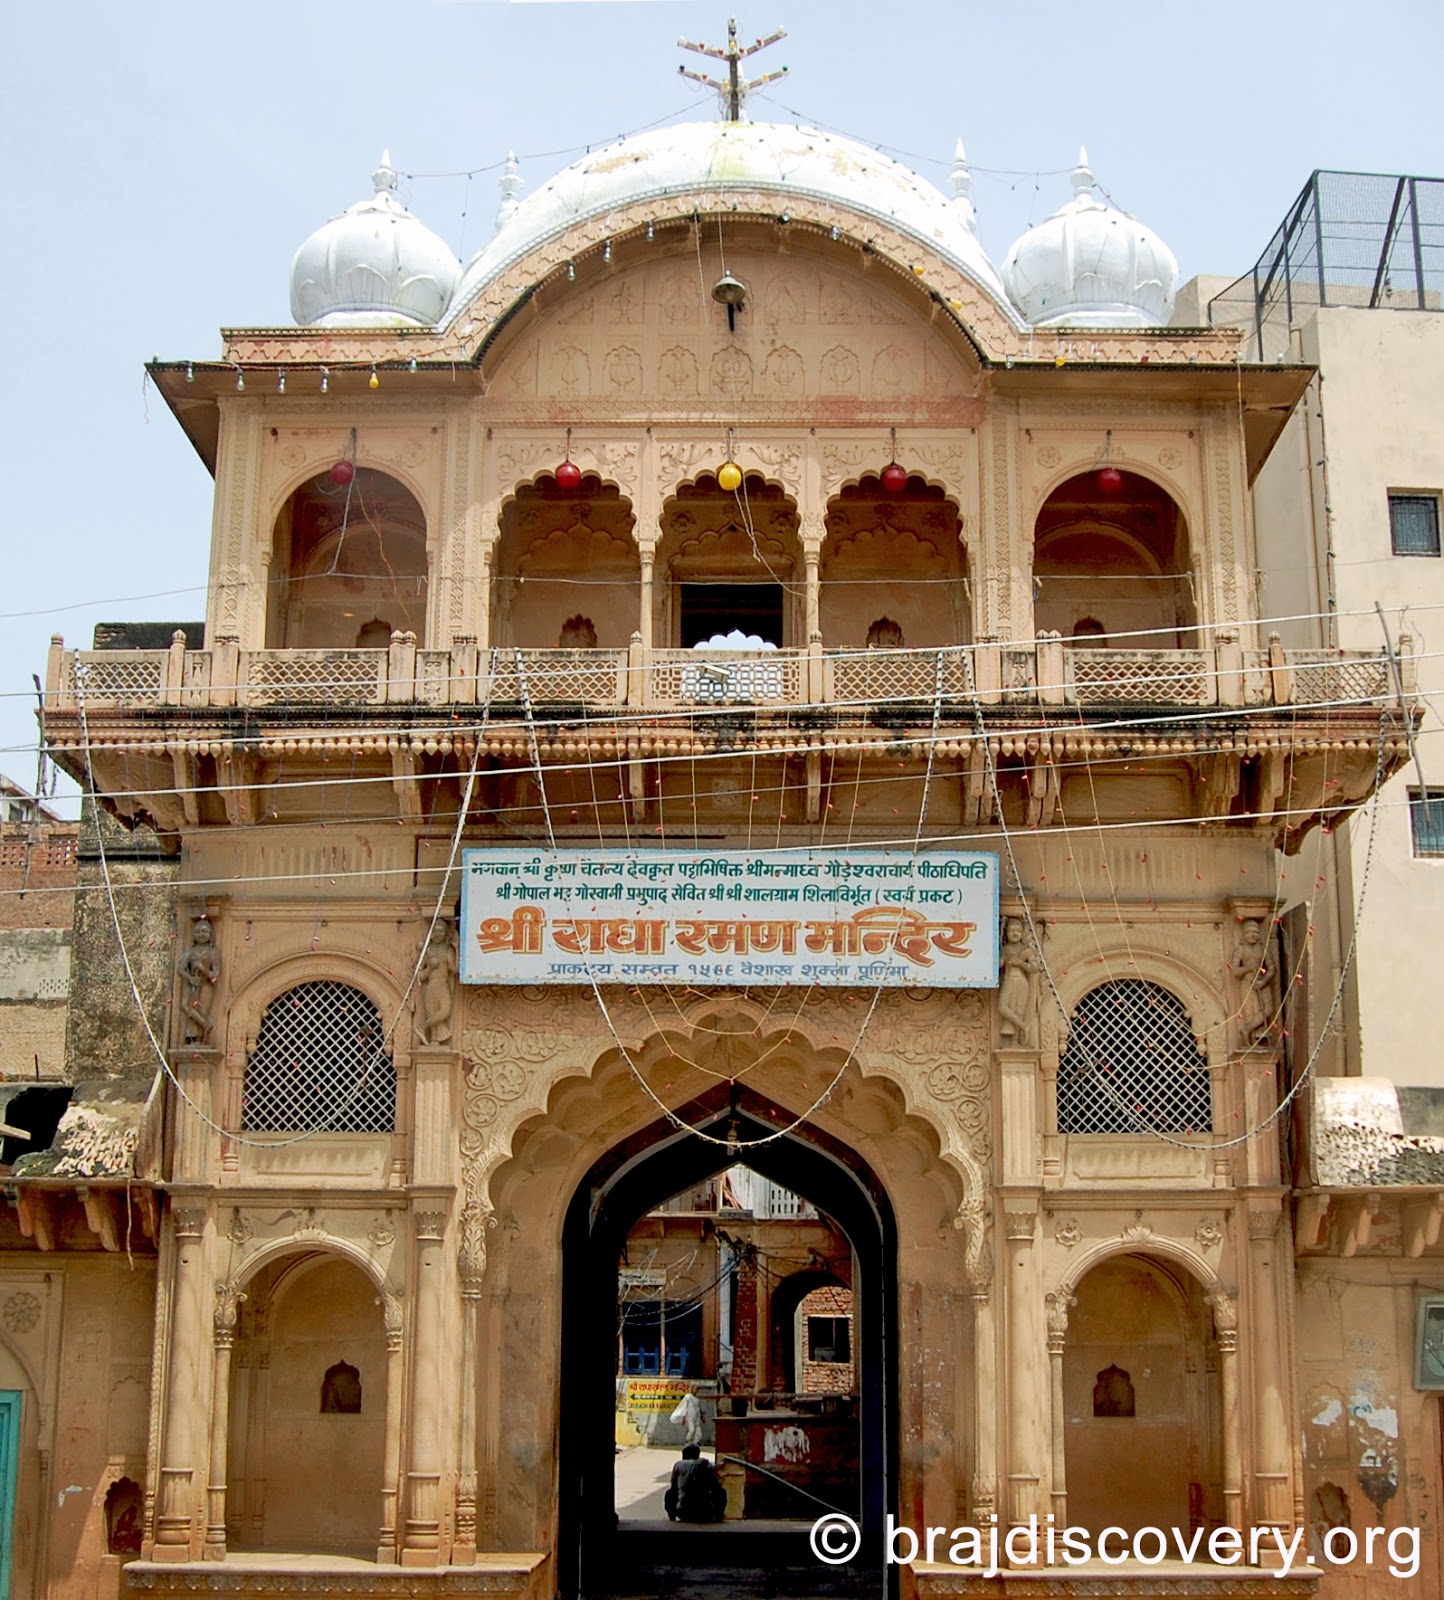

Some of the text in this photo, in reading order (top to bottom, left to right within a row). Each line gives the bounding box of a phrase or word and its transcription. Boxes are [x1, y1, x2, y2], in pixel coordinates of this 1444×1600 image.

[471, 862, 521, 879] भगवान्
[523, 857, 542, 875] श्री
[544, 862, 578, 881] कृष्ण
[917, 860, 988, 879] पीठाधिपति
[496, 882, 511, 900] श्री
[513, 882, 551, 900] गोपाल
[575, 882, 624, 900] गोस्वामी
[626, 887, 669, 906] प्रभुपाद
[671, 883, 707, 901] सेवित
[709, 883, 724, 901] श्री
[726, 883, 743, 902] श्री
[744, 888, 800, 902] शालग्राम
[476, 905, 977, 967] श्री राधा रमण मन्दिर
[621, 963, 679, 976] सम्वत
[740, 961, 794, 977] वैशाख
